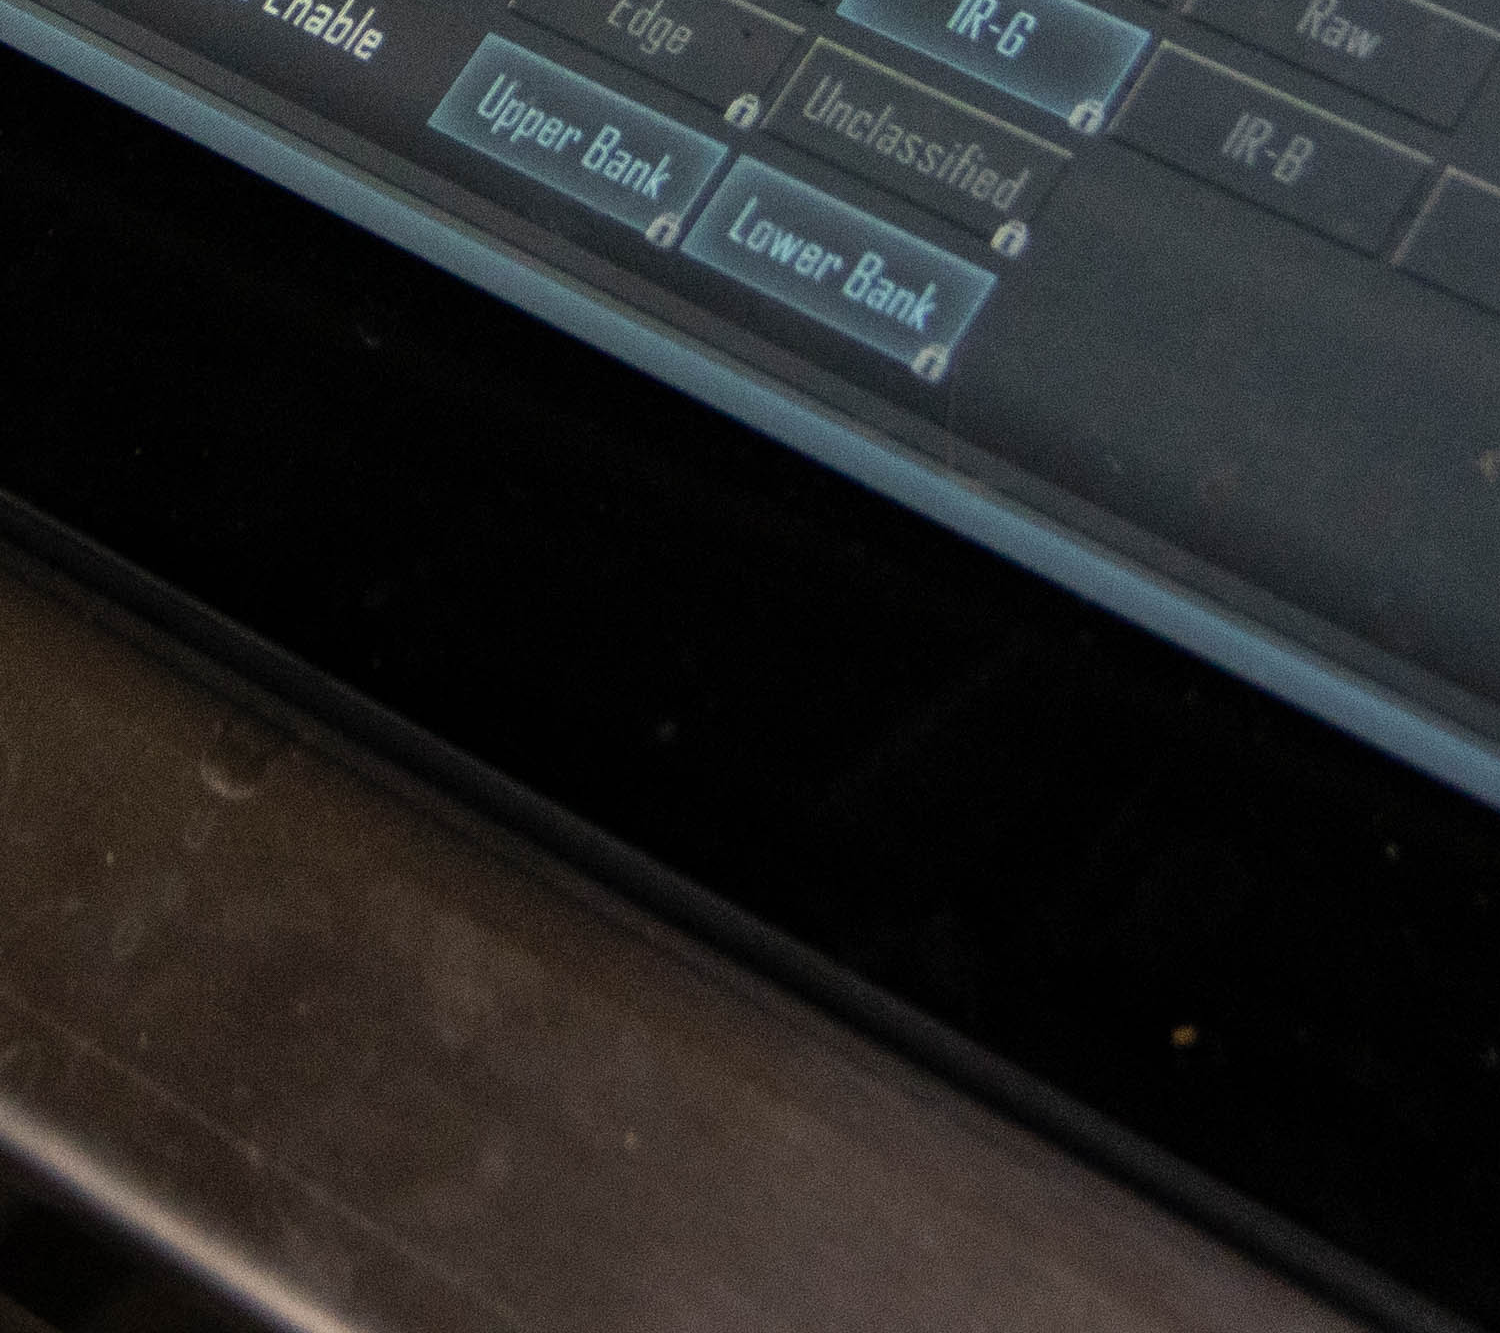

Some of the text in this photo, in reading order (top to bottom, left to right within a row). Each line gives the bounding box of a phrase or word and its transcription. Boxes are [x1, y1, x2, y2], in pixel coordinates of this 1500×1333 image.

[478, 73, 585, 163] Upper
[582, 121, 672, 201] Bank
[726, 197, 844, 284] Lower
[841, 252, 938, 331] Bank
[801, 74, 1031, 213] Unclassified
[1220, 114, 1314, 189] IR-B
